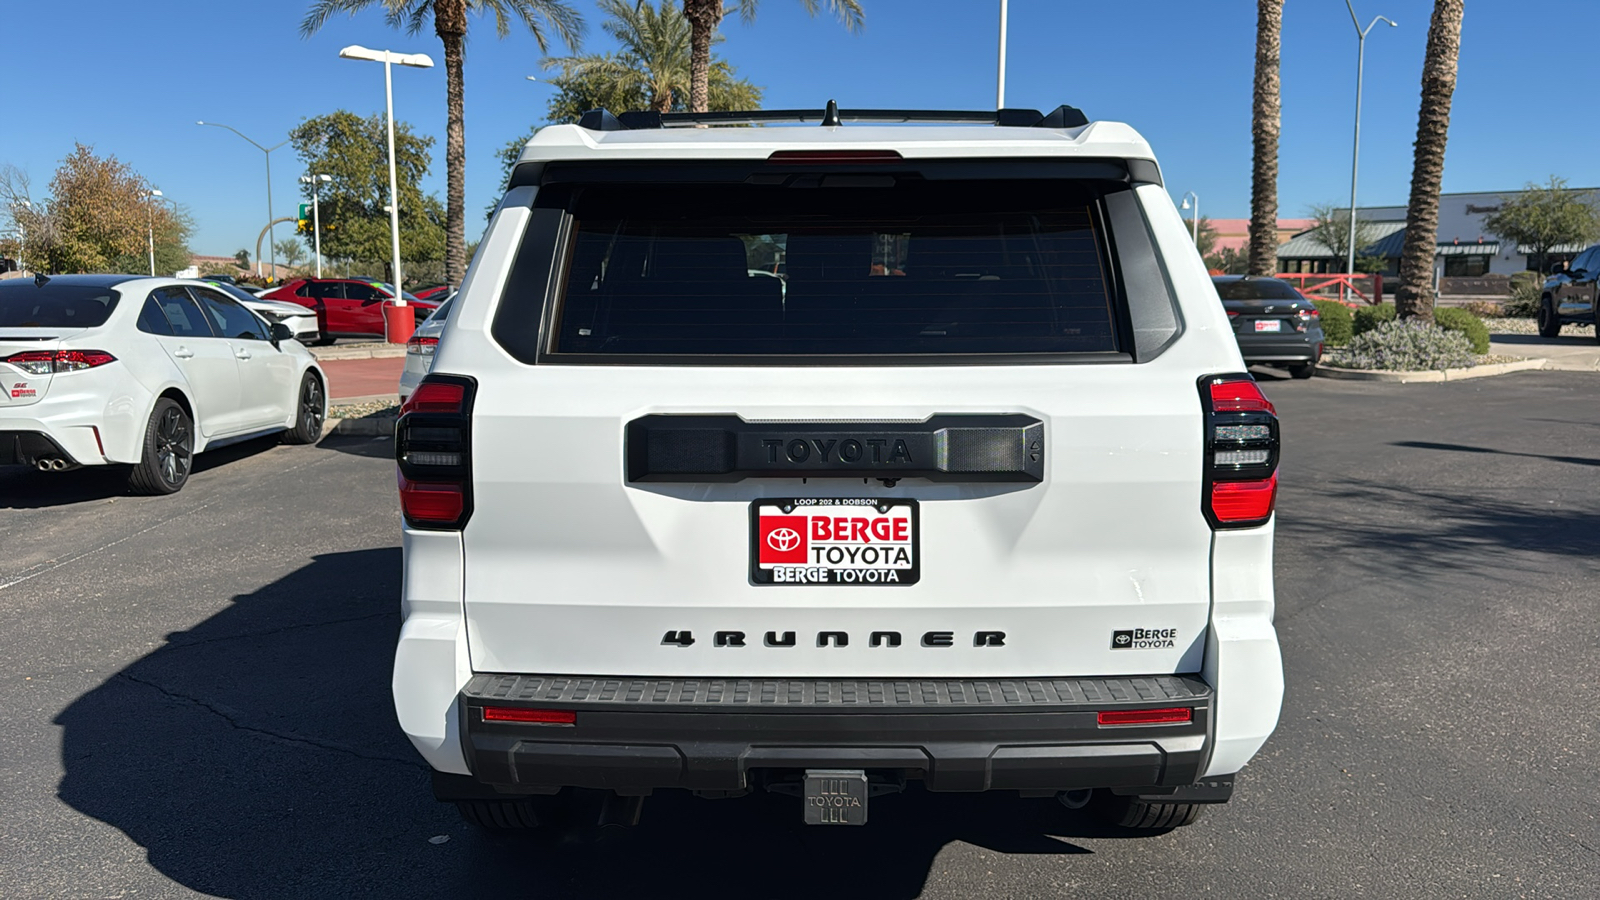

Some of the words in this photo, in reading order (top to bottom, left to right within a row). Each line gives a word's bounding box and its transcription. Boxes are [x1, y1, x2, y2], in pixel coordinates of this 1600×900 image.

[761, 438, 913, 464] TOYOTA
[842, 498, 878, 506] DOBSON
[810, 515, 909, 544] BERGE
[810, 546, 911, 565] TOYOTA
[773, 566, 829, 583] BERGE
[833, 569, 900, 583] TOYOTA
[660, 630, 1006, 648] 4RUNNER
[1134, 628, 1177, 640] BERGE
[1133, 639, 1175, 649] TOYOTA
[807, 796, 861, 807] TOYOTA
